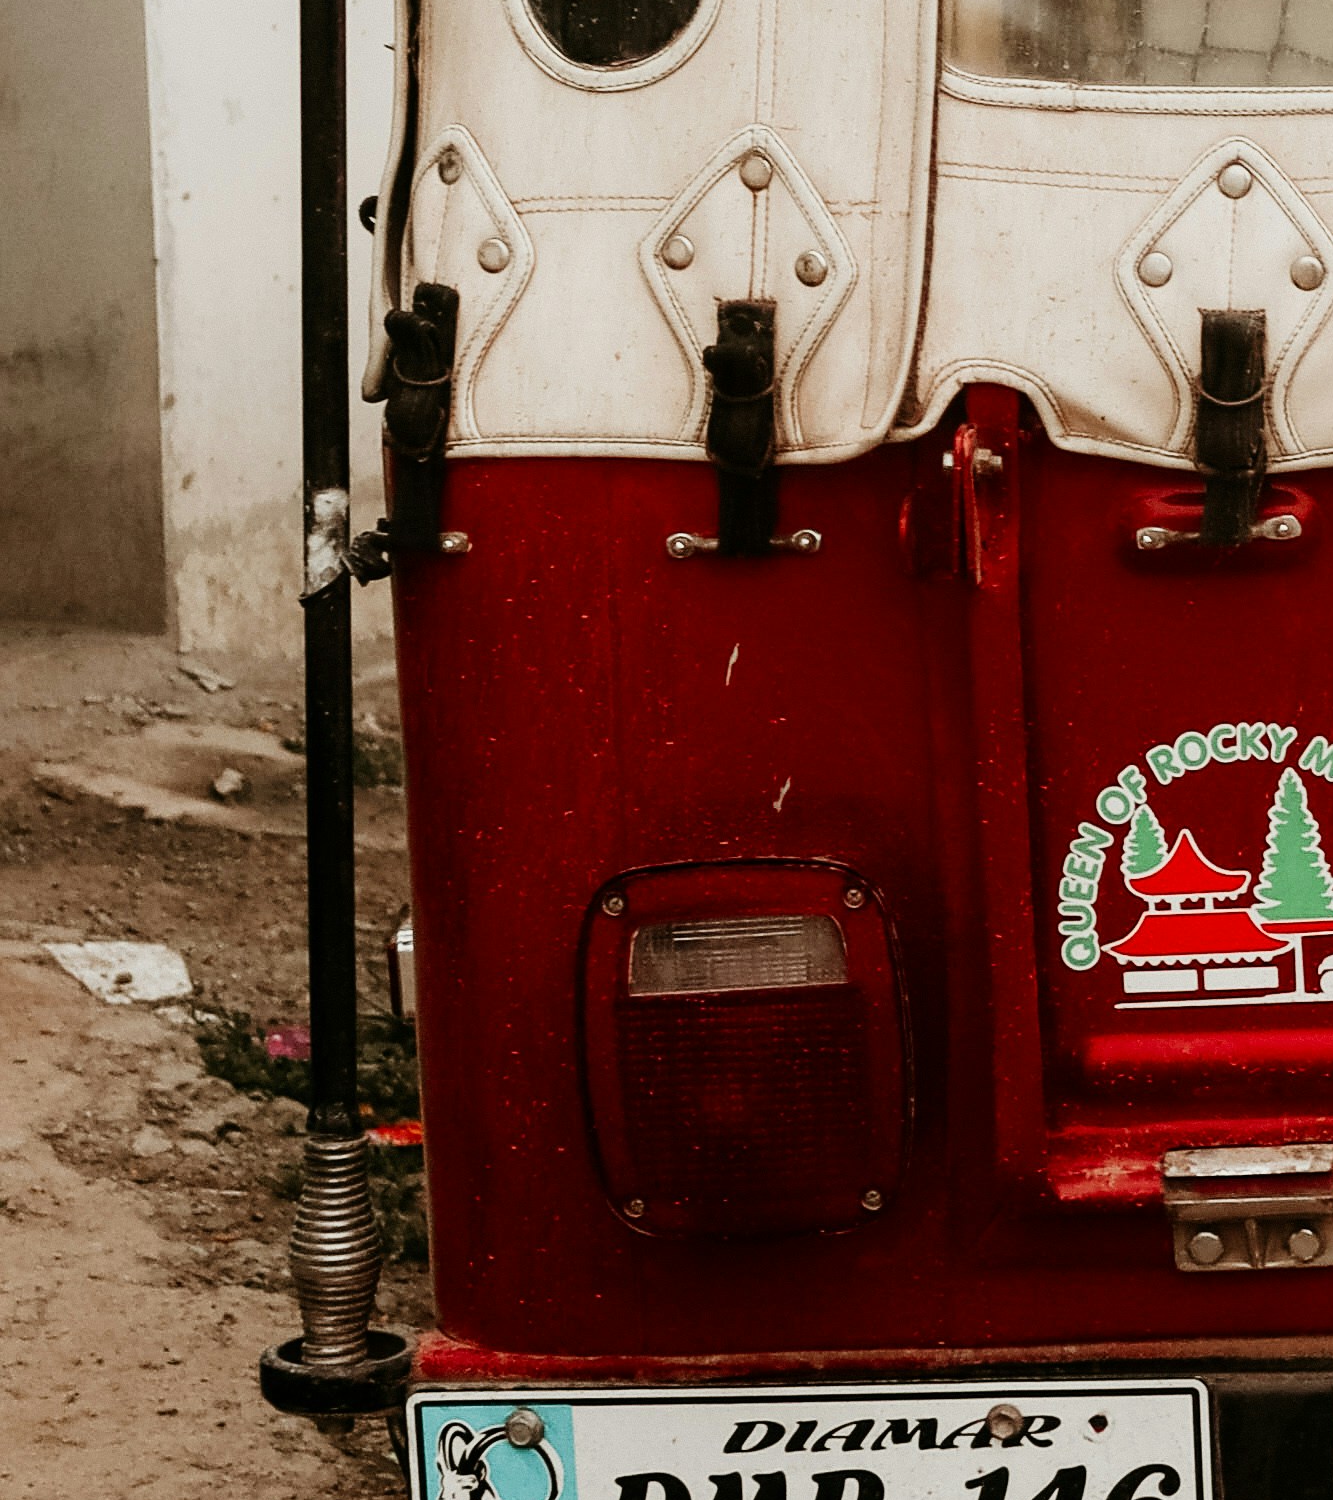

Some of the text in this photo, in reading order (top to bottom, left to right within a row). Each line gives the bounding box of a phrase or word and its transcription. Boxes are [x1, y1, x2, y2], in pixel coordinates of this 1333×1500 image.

[1058, 821, 1114, 971] QUEEN
[1096, 764, 1147, 824] OF
[1145, 722, 1298, 785] ROCKY
[722, 1414, 1062, 1454] DIAMAR
